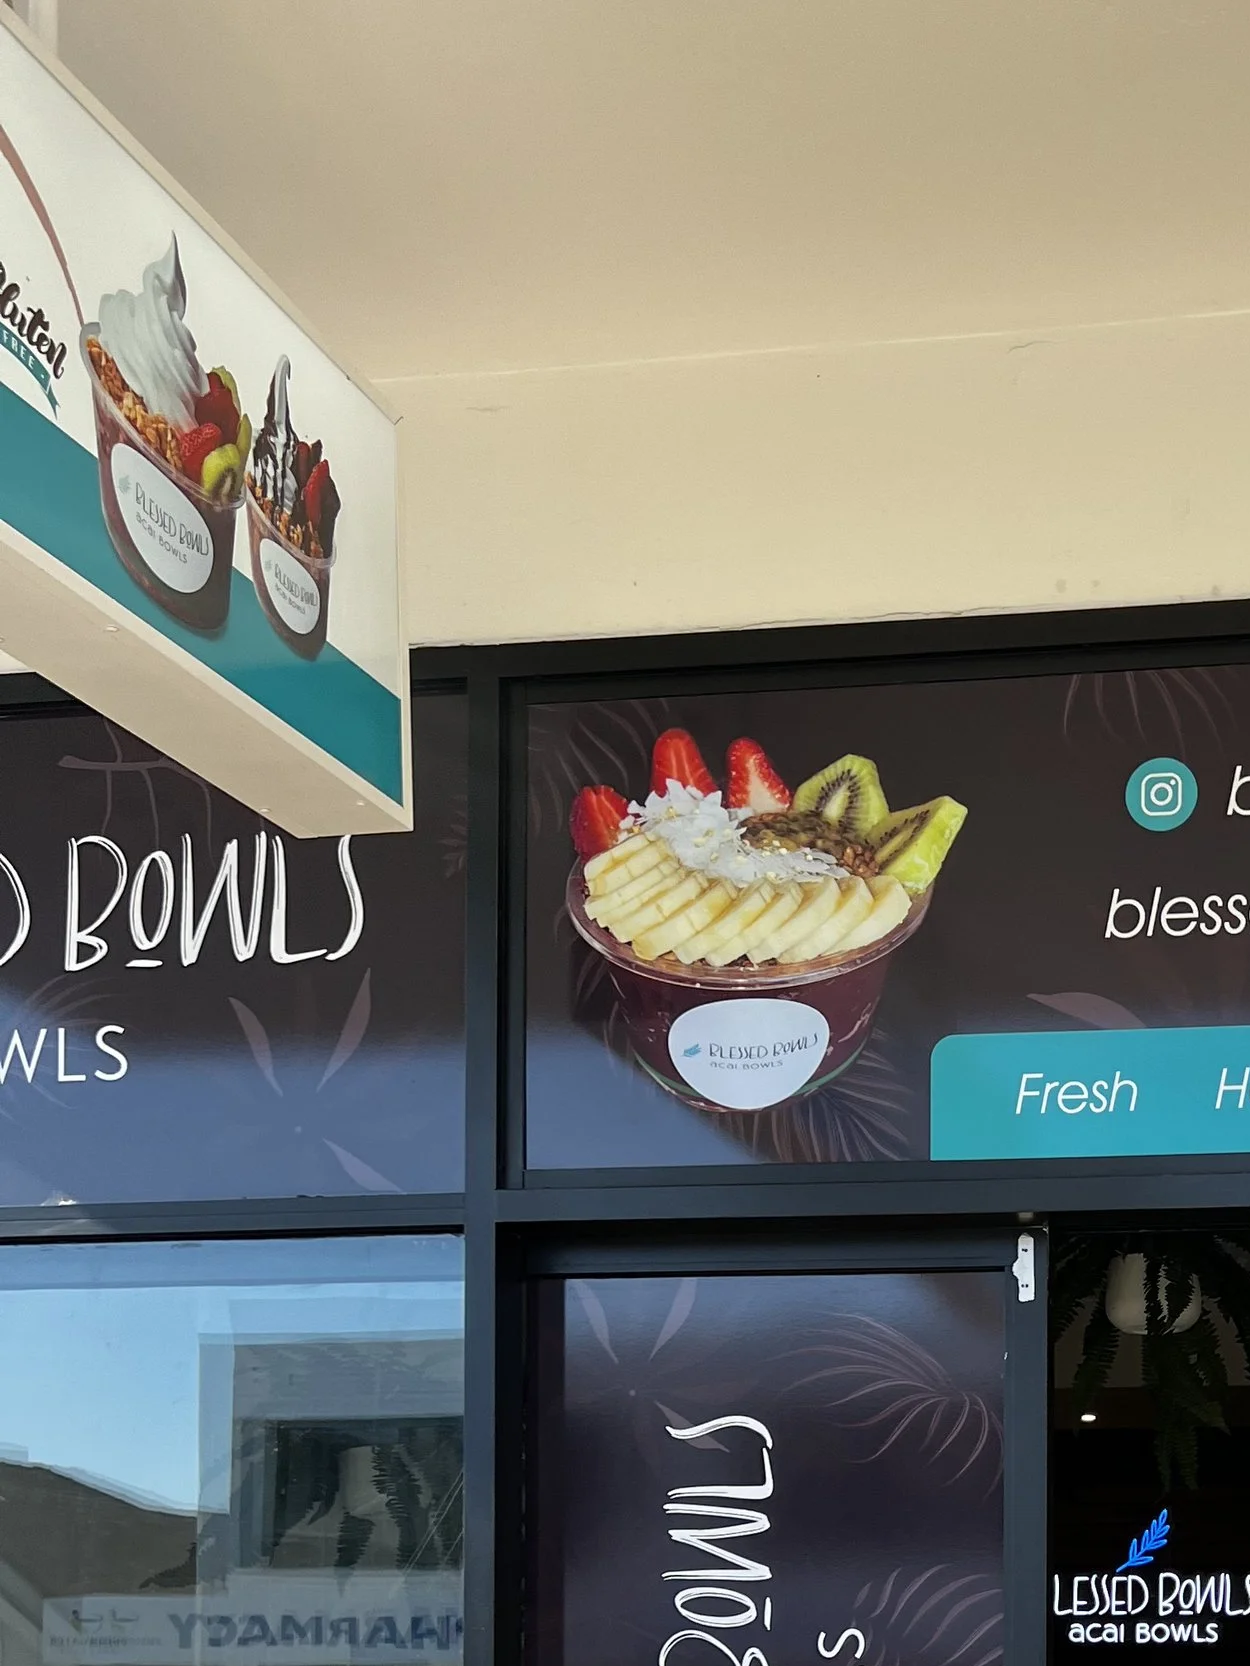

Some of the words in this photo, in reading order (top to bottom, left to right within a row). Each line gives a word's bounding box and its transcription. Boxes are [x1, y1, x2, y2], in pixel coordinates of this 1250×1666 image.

[3, 331, 35, 370] FREE
[159, 535, 188, 564] BOWLS
[64, 831, 365, 972] BOWLS
[709, 1042, 768, 1060] BLESSED
[773, 1032, 818, 1056] BOWLS
[742, 1060, 784, 1070] BOWLS
[1016, 1070, 1138, 1115] Fresh
[1053, 1573, 1149, 1616] LESSED
[1068, 1622, 1126, 1644] acai
[1135, 1622, 1219, 1644] BOWLS
